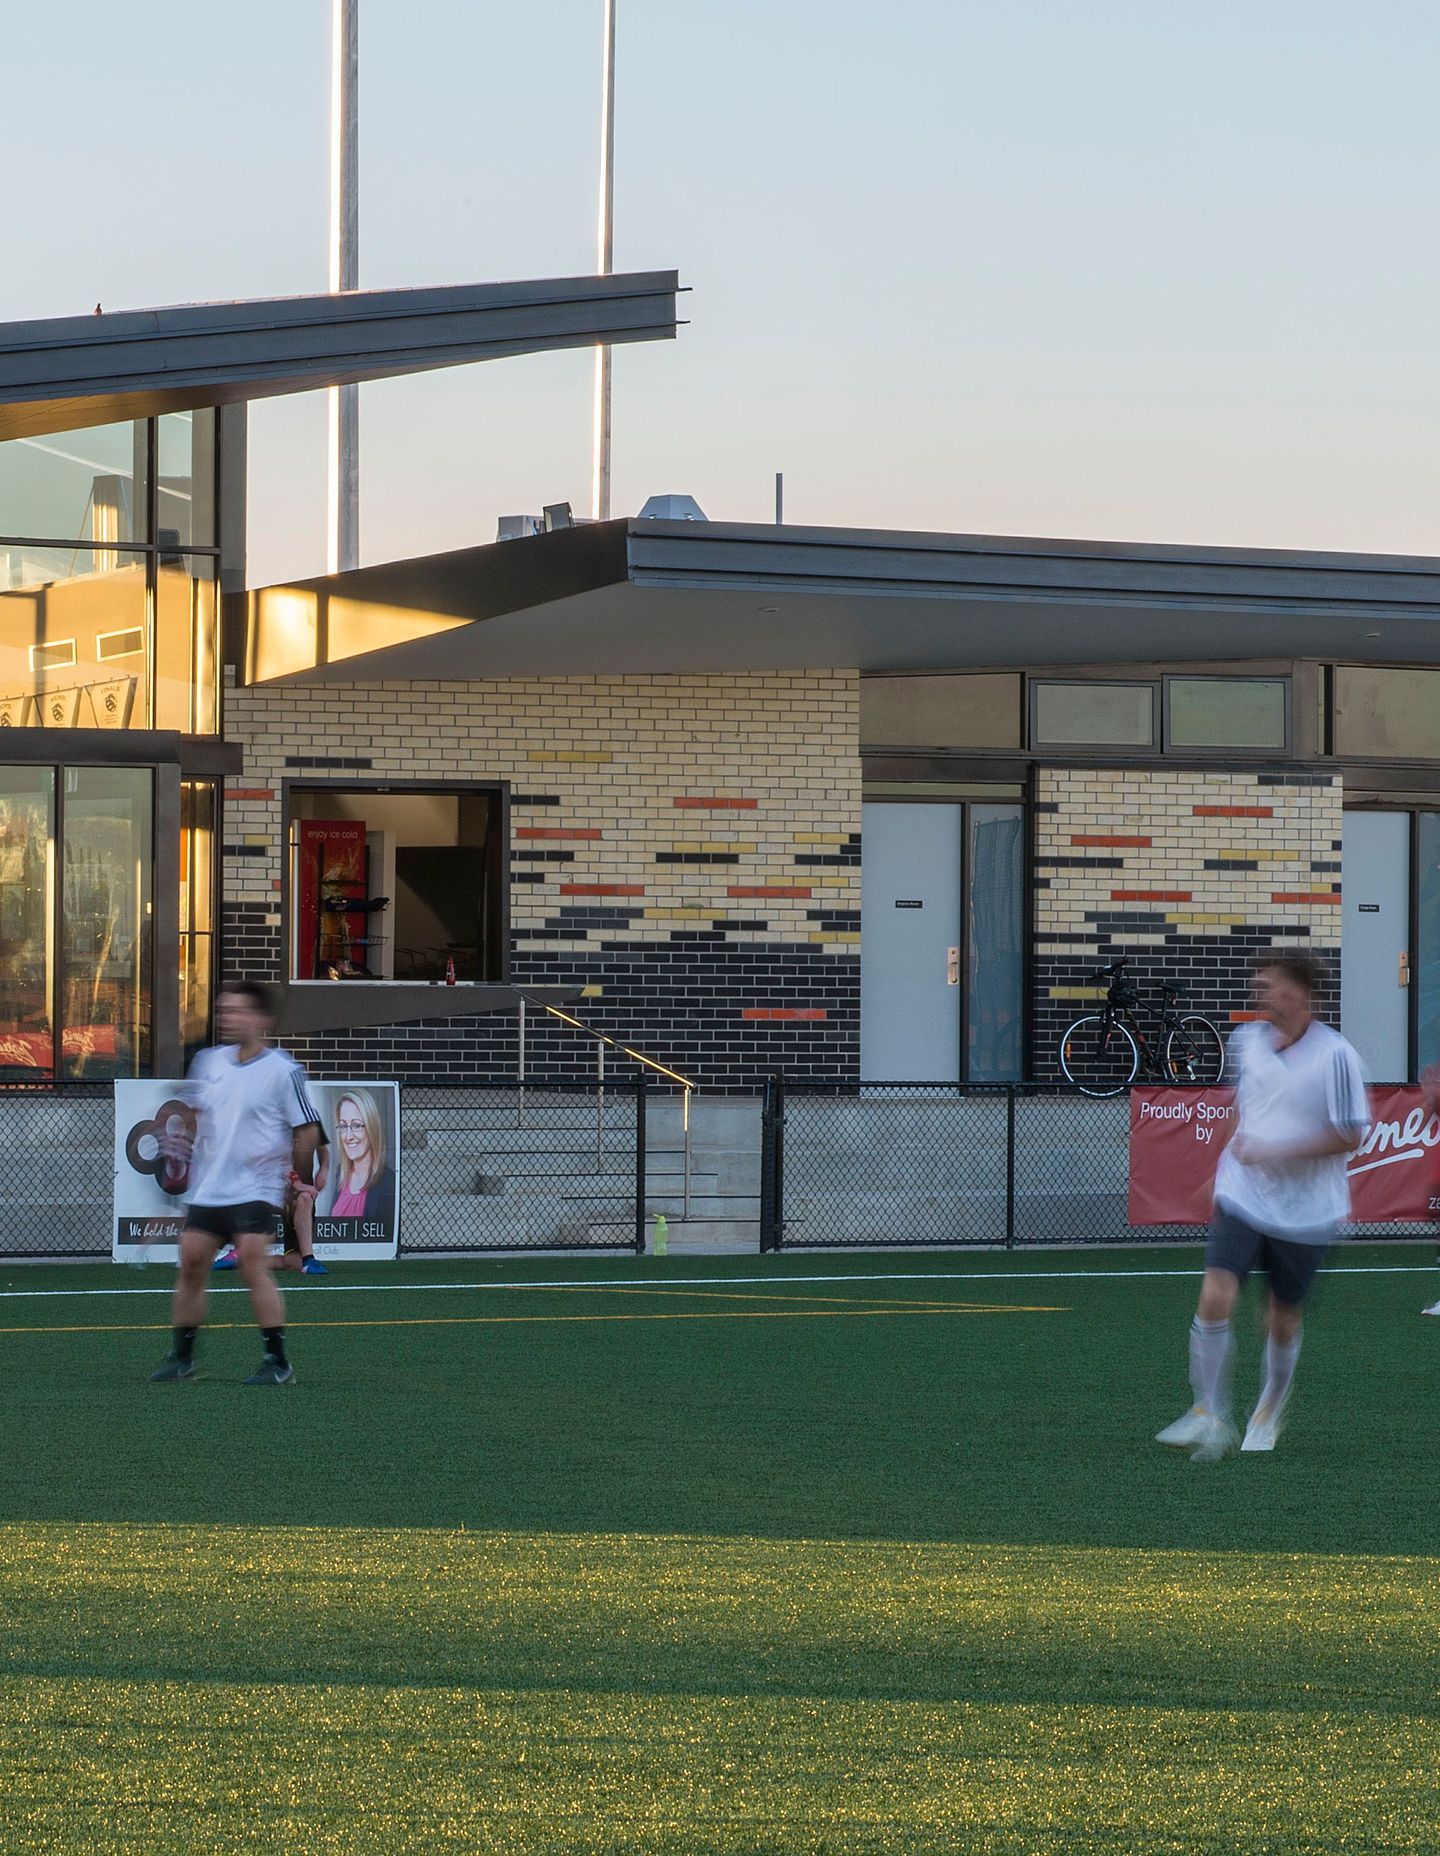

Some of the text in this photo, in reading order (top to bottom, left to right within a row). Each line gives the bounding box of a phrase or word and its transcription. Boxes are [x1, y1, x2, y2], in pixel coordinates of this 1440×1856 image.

[307, 830, 358, 840] enjoy ice cold
[1140, 1102, 1193, 1123] Proudly
[1195, 1123, 1214, 1145] by
[129, 1221, 141, 1237] We
[143, 1222, 163, 1238] hold
[166, 1222, 178, 1237] the
[316, 1222, 385, 1238] RENT SELL
